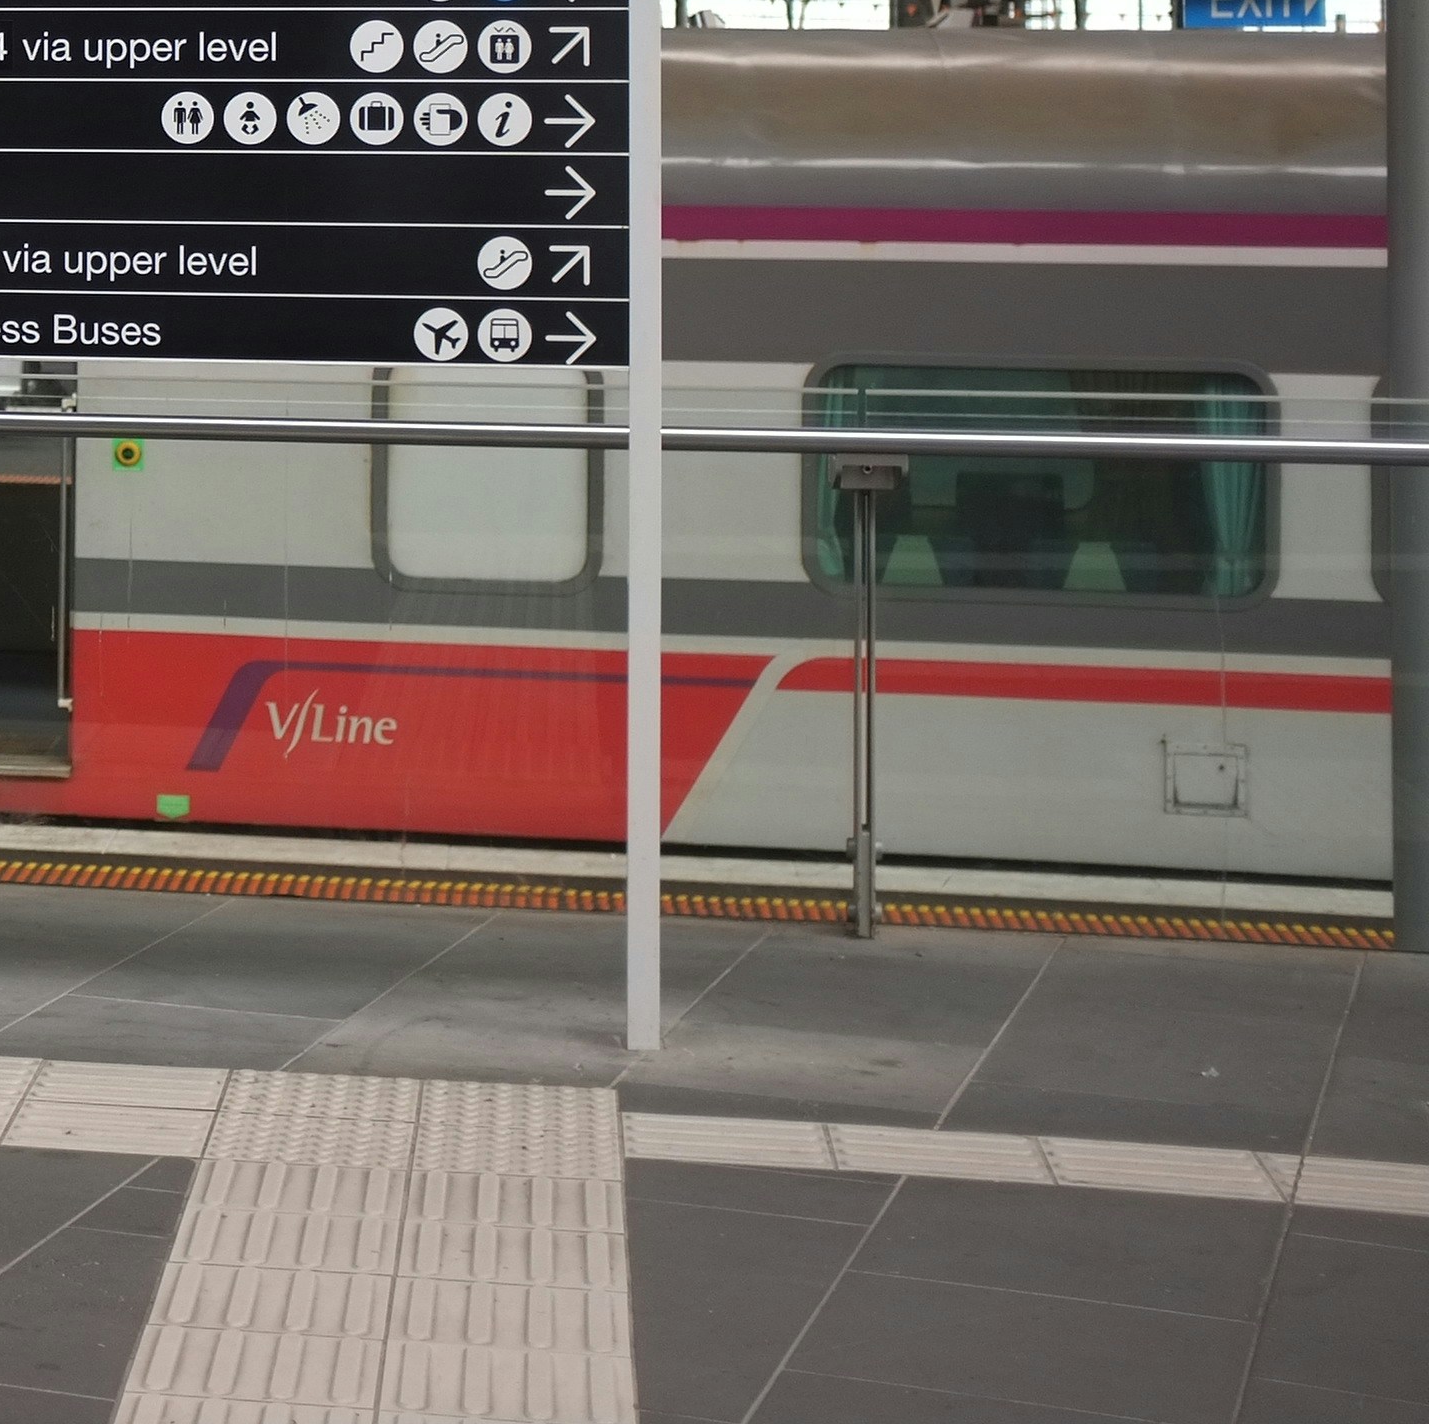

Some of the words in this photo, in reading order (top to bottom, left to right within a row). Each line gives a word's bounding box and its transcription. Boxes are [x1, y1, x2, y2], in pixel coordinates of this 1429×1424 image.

[23, 31, 71, 62] via
[85, 38, 186, 69] upper
[200, 31, 276, 62] level
[3, 243, 51, 273] via
[65, 251, 167, 282] upper
[180, 244, 256, 276] level
[54, 313, 161, 346] Buses
[265, 688, 398, 760] V/Line
